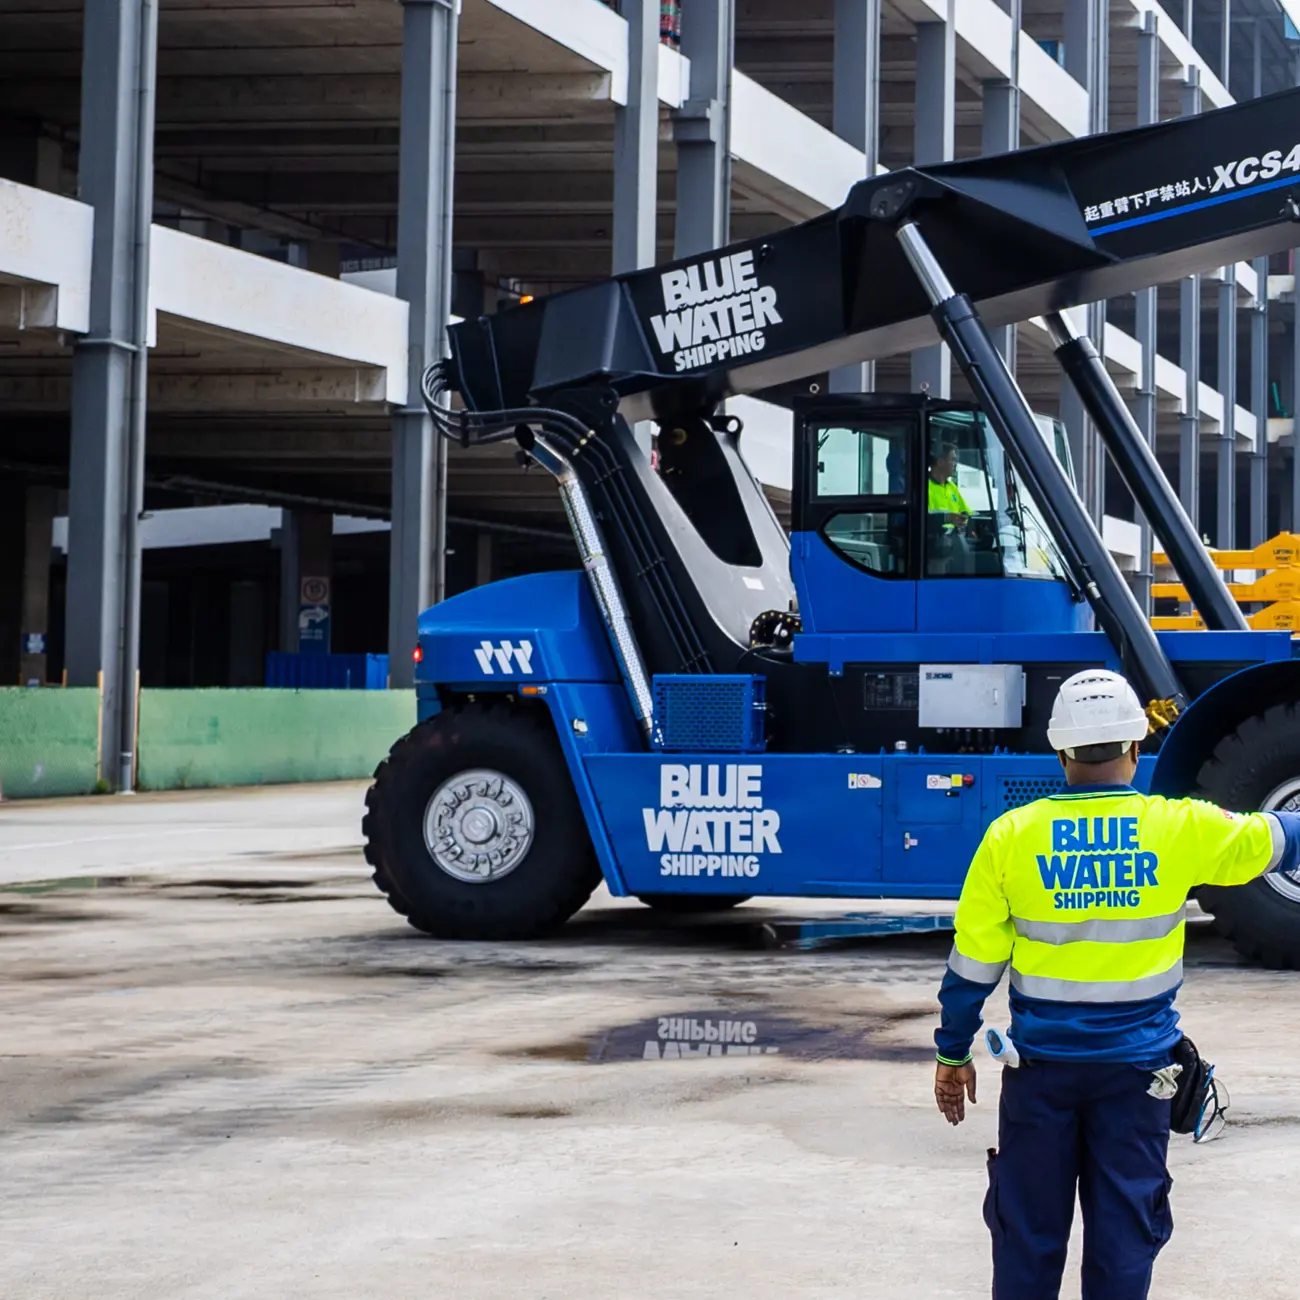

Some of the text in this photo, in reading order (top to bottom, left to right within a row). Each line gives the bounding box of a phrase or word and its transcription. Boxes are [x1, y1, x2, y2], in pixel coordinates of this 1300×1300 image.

[660, 249, 758, 312] BLUE
[650, 285, 783, 354] WATER
[673, 330, 766, 372] SHIPPING
[660, 764, 763, 808] BLUE
[642, 808, 783, 853] WATER
[1052, 817, 1139, 852] BLUE
[660, 854, 760, 877] SHIPPING
[1035, 851, 1159, 890] WATER
[1053, 890, 1140, 909] SHIPPING
